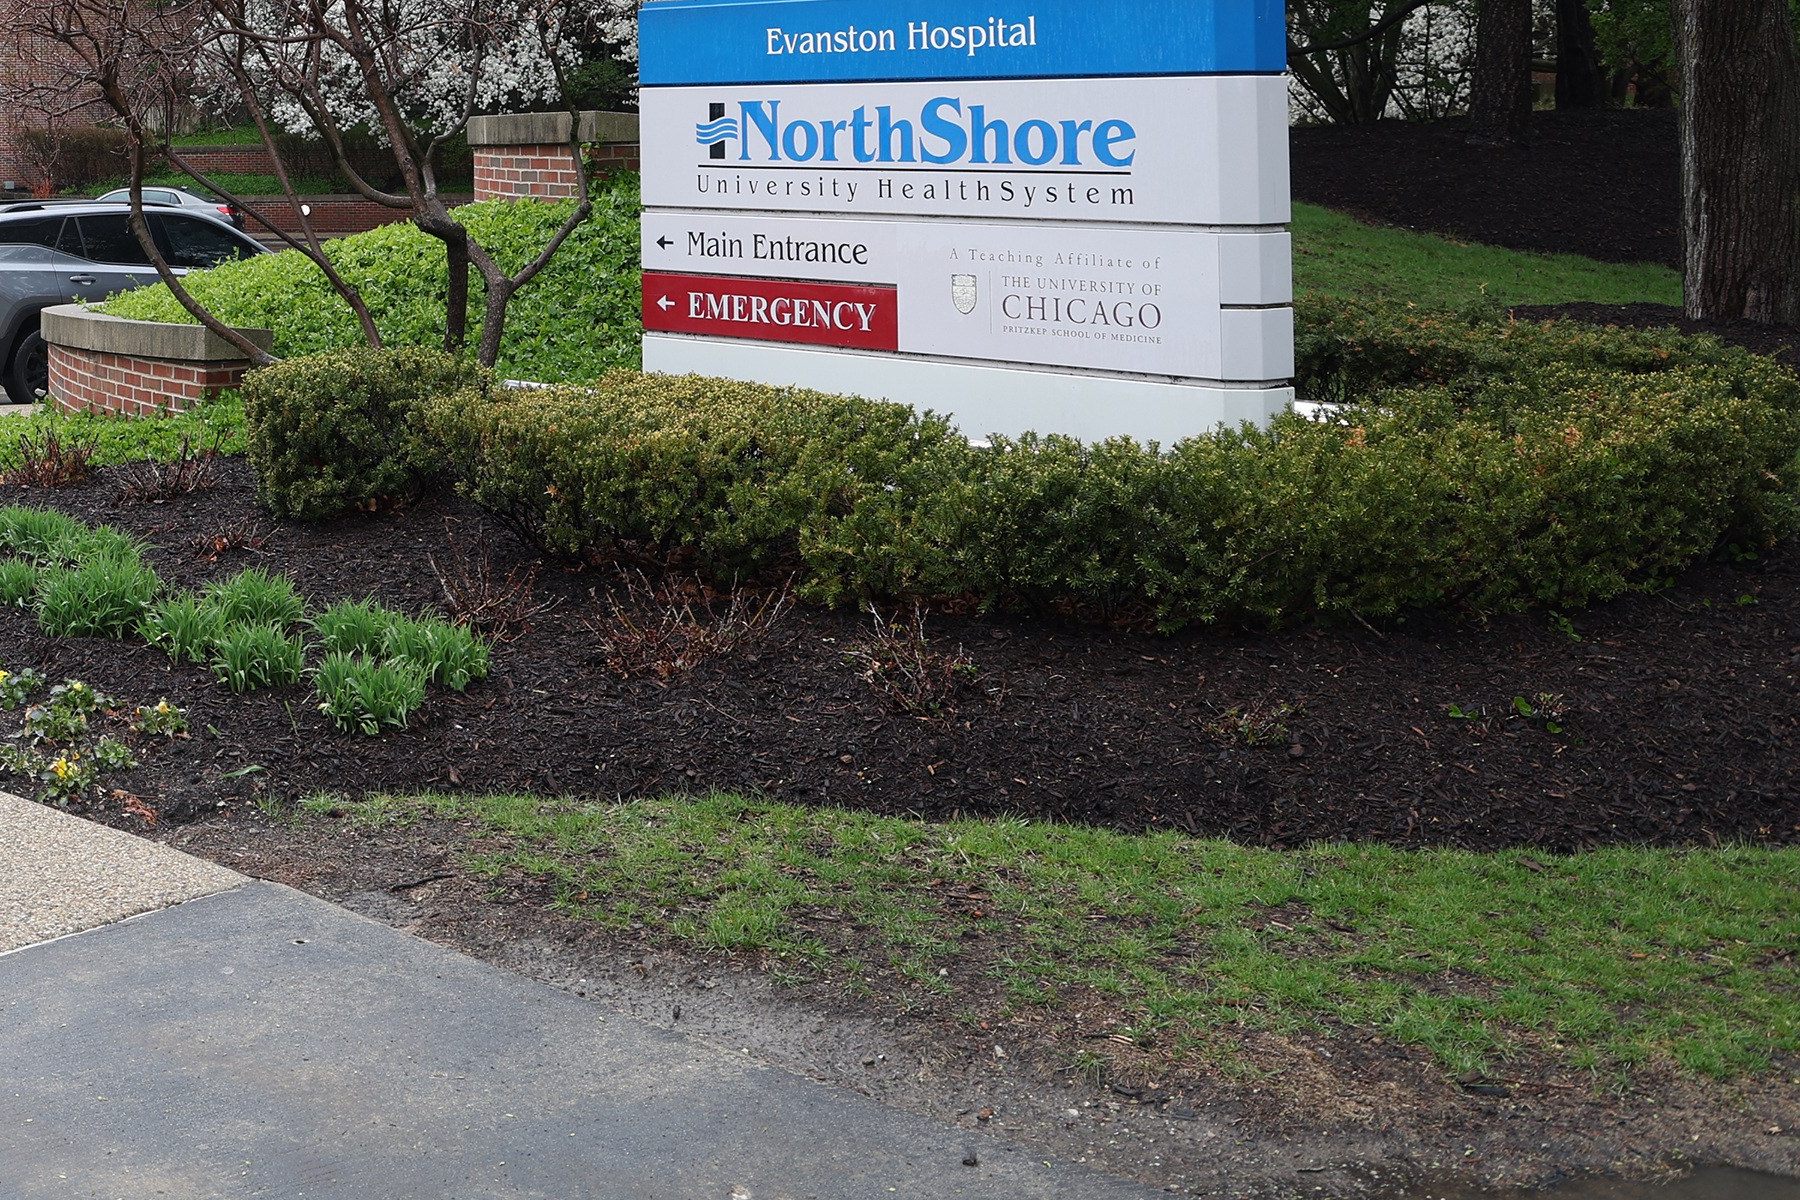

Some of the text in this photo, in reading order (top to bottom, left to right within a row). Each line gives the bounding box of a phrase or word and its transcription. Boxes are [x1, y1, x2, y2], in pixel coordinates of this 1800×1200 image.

[766, 15, 1037, 57] Evanston Hospital
[737, 96, 1137, 167] NorthShore
[696, 174, 1135, 207] University HealthSystem
[687, 231, 869, 265] Main Entrance
[949, 247, 1162, 270] A Teaching Affiliate of
[1001, 275, 1162, 296] THE UNIVERSITY OF
[687, 291, 877, 332] EMERGENCY
[1001, 293, 1162, 330] CHICAGO
[1051, 328, 1091, 340] SCHOOL
[1094, 331, 1107, 341] OF
[1110, 333, 1162, 345] MEDICINE
